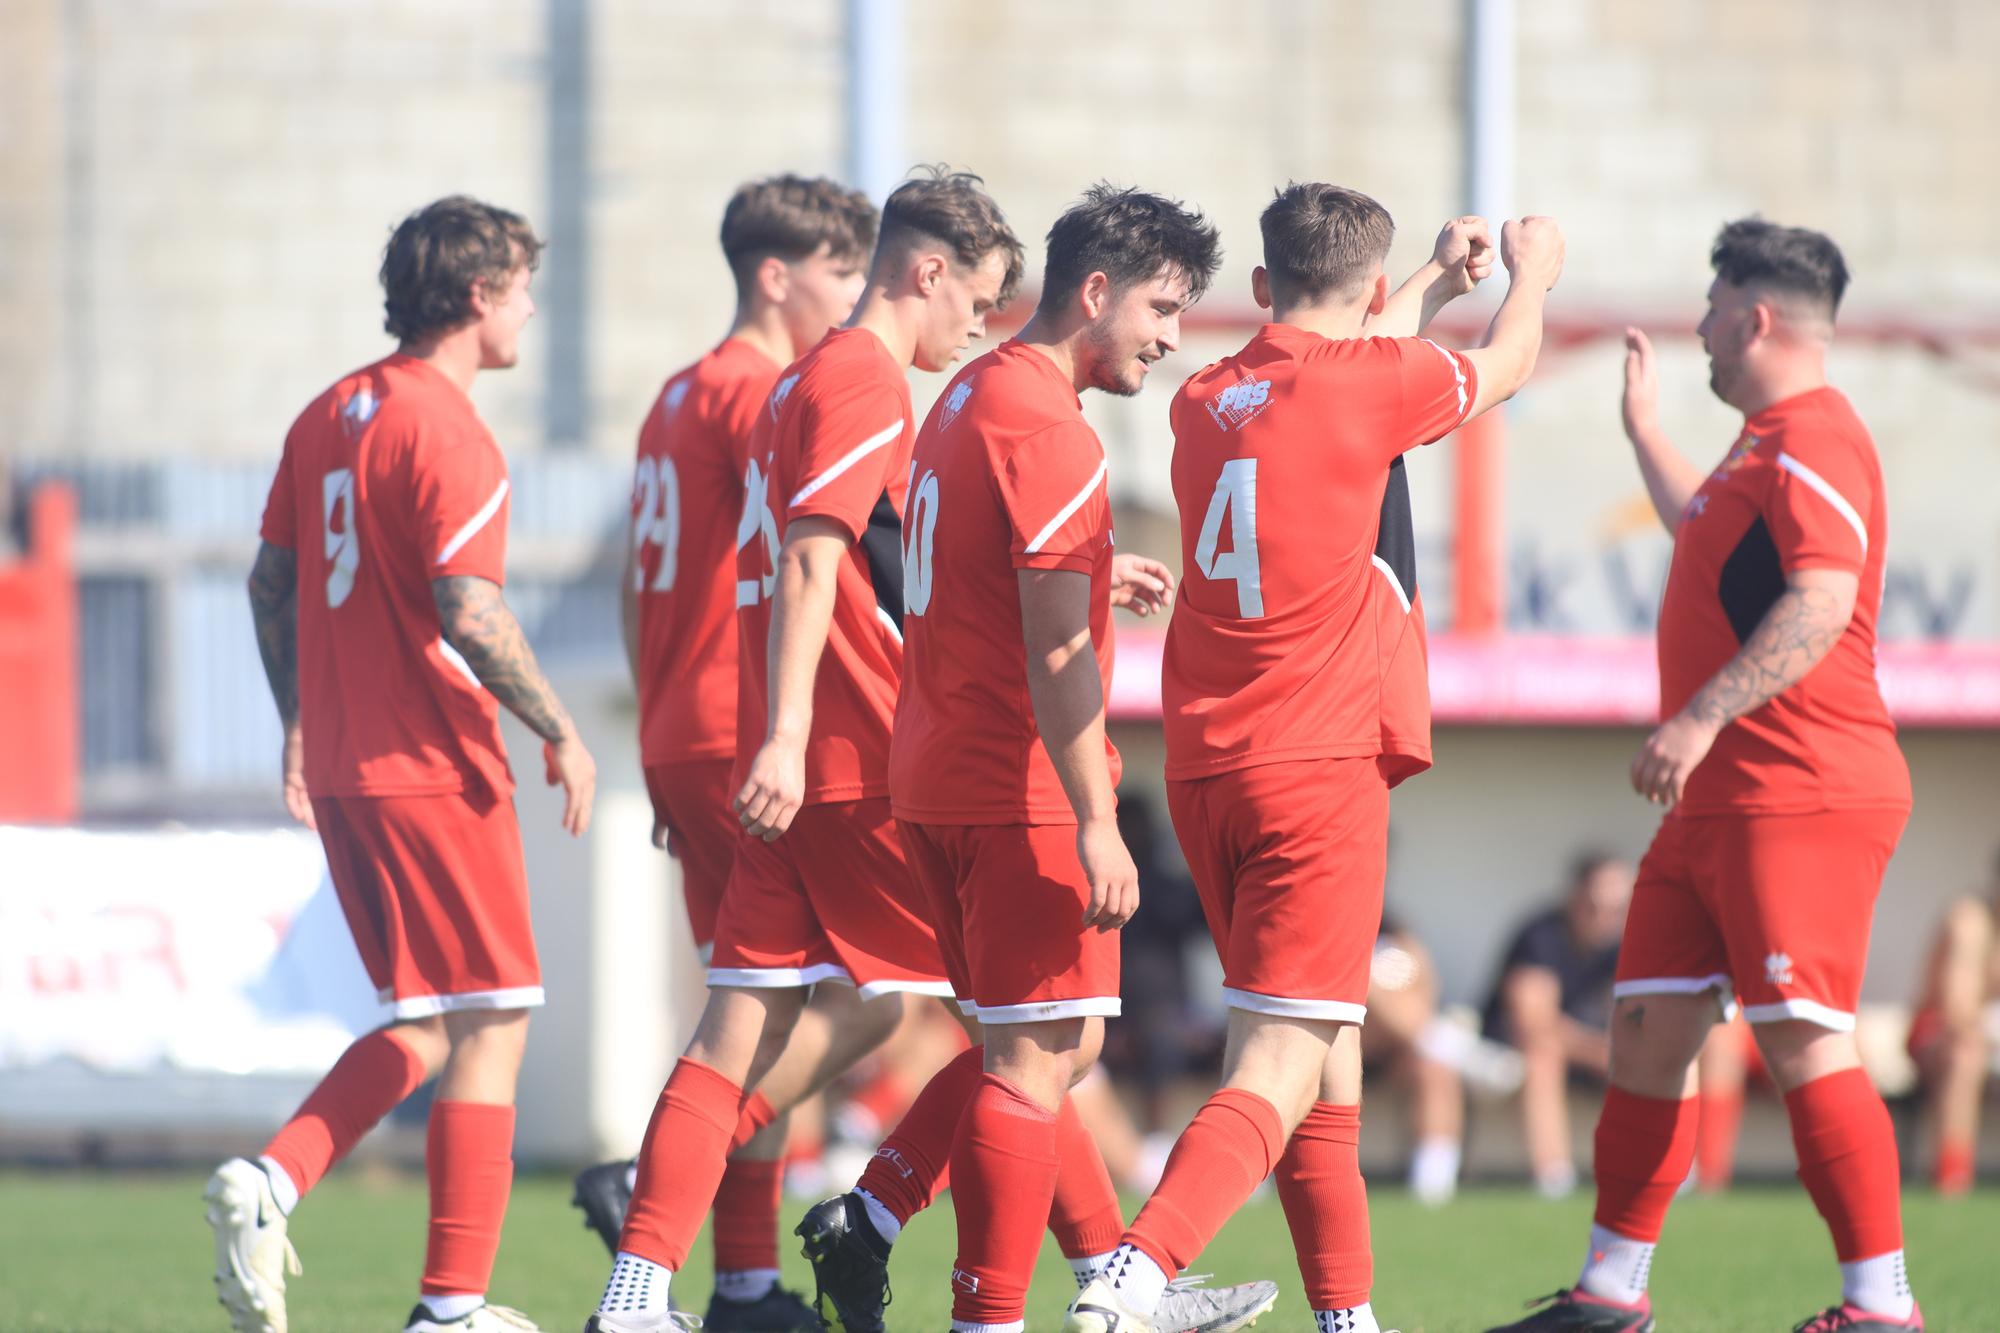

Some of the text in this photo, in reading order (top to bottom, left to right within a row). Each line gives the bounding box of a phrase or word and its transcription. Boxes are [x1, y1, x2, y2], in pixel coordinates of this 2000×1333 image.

[1217, 379, 1272, 413] PBS
[323, 468, 360, 609] 9
[1194, 457, 1264, 619] 4
